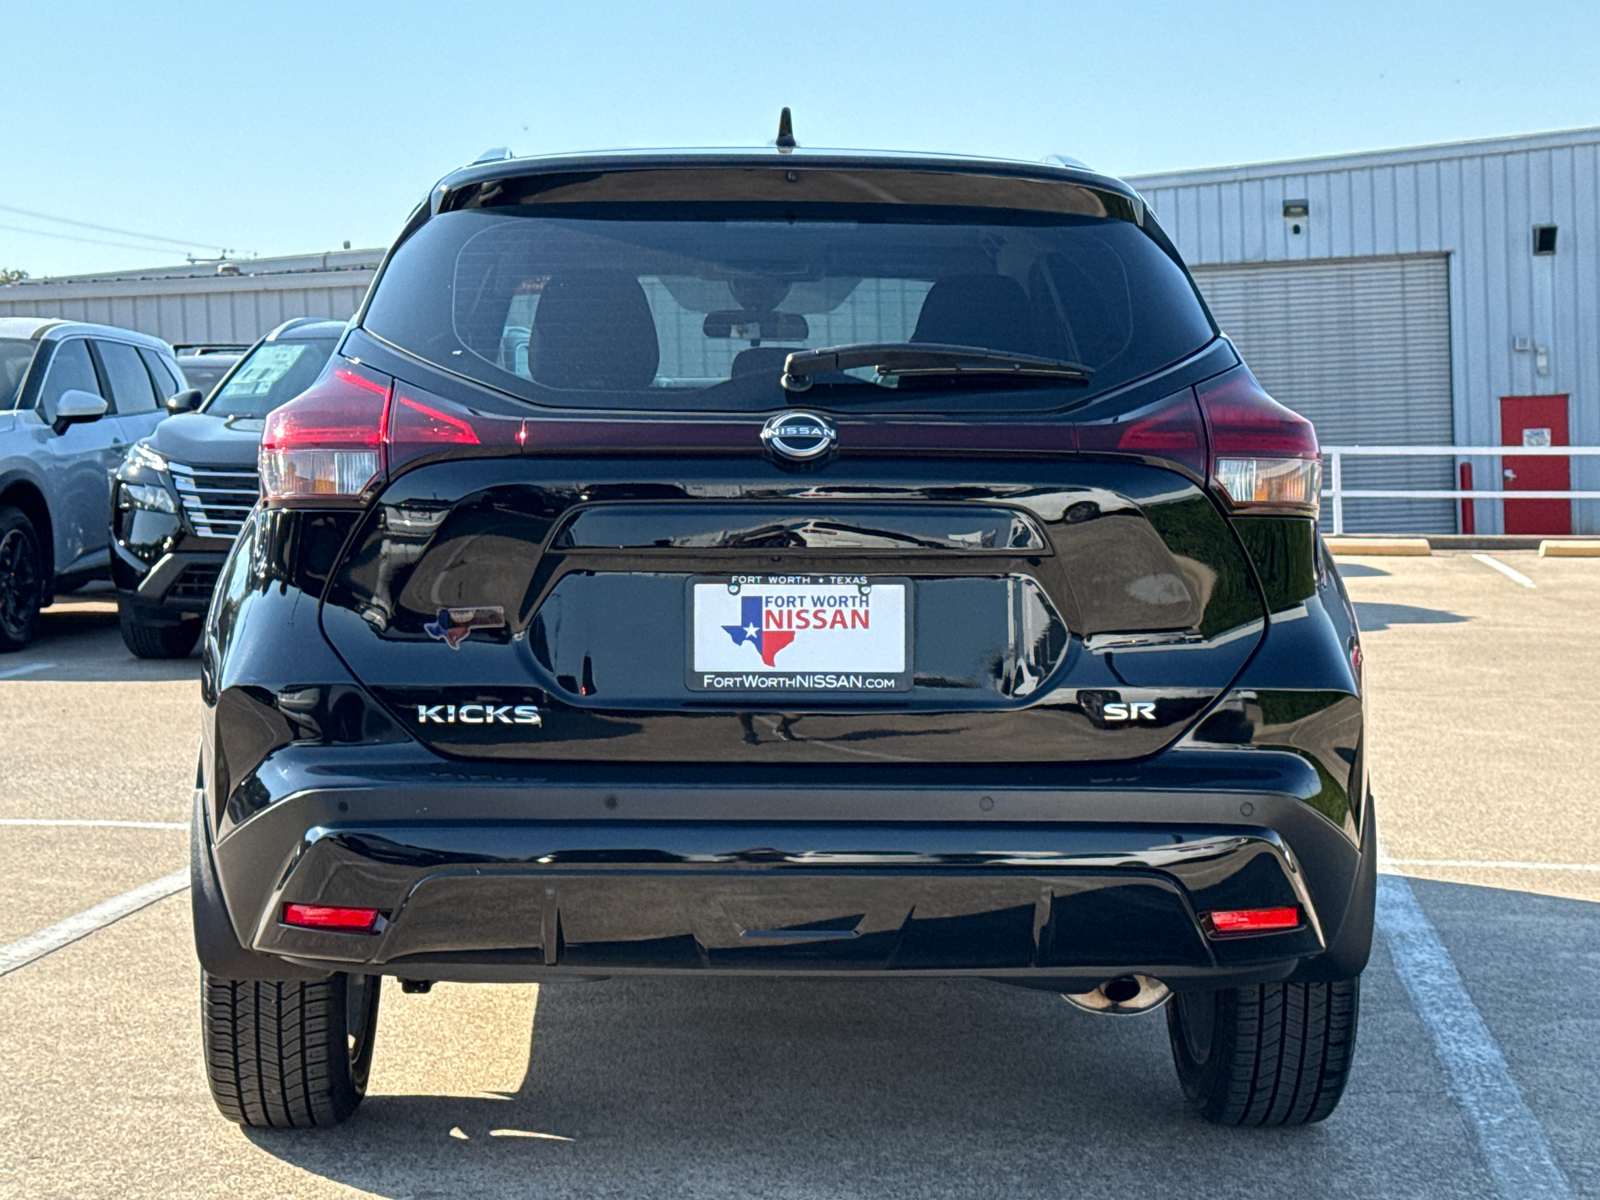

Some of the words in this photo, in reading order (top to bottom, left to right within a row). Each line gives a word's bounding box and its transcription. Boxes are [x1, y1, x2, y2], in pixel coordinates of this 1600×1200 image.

[769, 427, 835, 437] NISSAN
[731, 575, 762, 584] FORT
[768, 575, 811, 584] WORTH
[829, 576, 868, 584] TEXAS
[765, 595, 806, 608] FORT
[811, 595, 870, 608] WORTH
[765, 609, 870, 630] NISSAN
[417, 704, 542, 724] KICKS
[1103, 702, 1157, 721] SR
